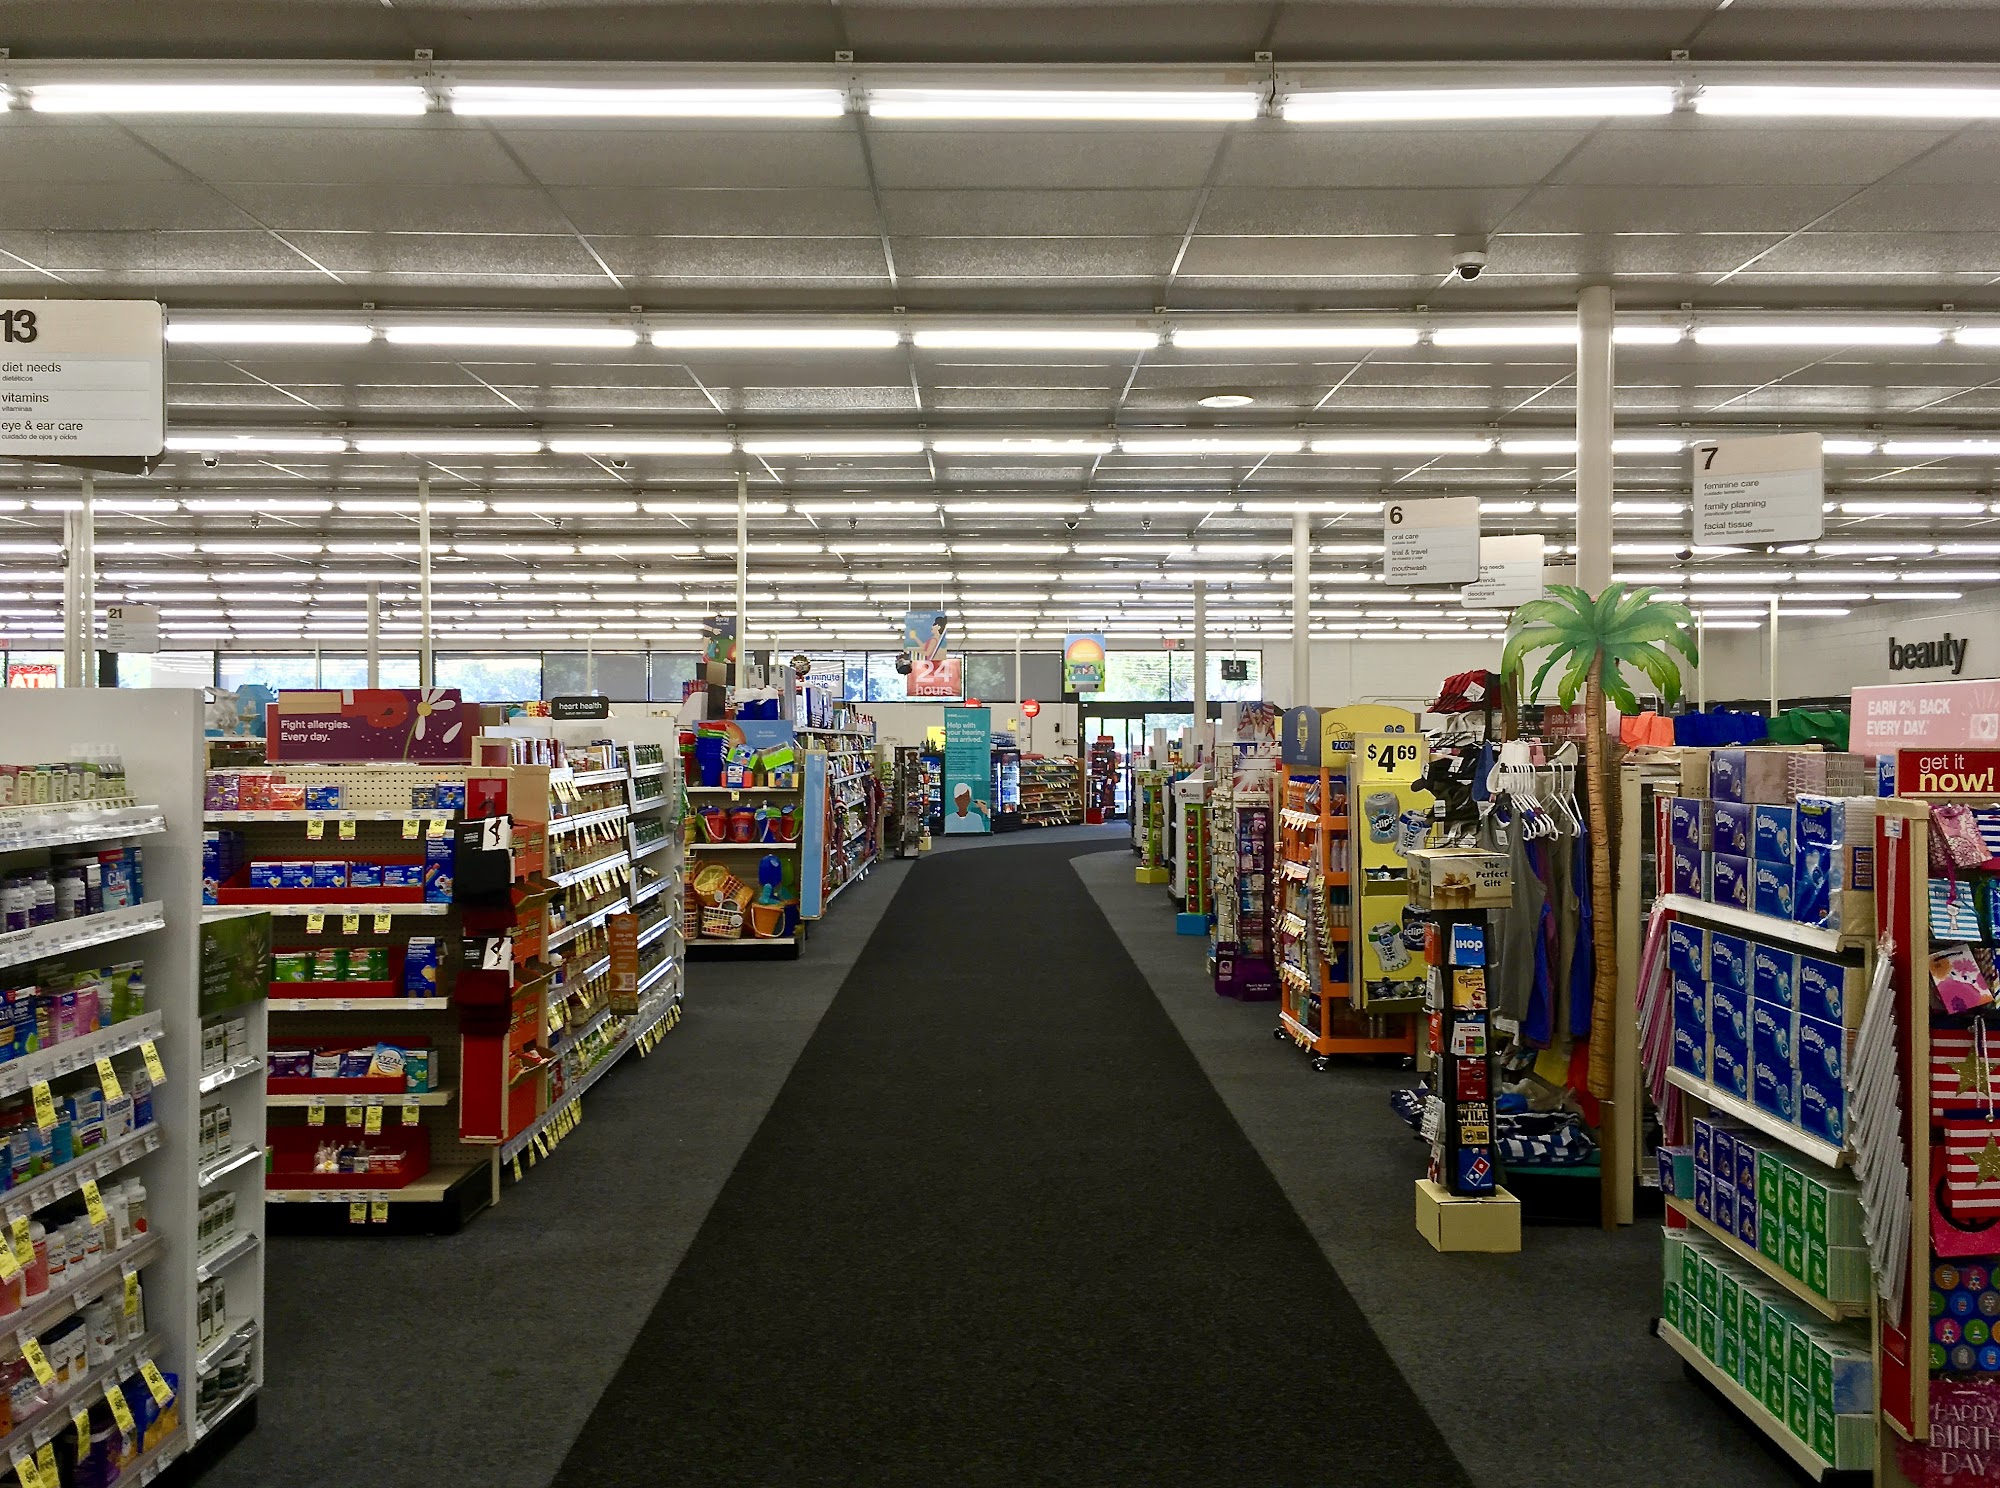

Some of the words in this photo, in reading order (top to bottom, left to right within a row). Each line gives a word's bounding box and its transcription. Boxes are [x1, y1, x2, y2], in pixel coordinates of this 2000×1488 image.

[0, 309, 38, 343] 13
[2, 362, 23, 372] diet
[26, 362, 62, 372] needs
[1, 392, 49, 403] vitamins
[1, 422, 21, 432] eye
[25, 421, 33, 431] &
[36, 422, 55, 431] ear
[58, 422, 83, 431] care
[1701, 447, 1718, 470] 7
[1704, 480, 1739, 490] feminine
[1740, 479, 1760, 488] care
[1704, 502, 1729, 511] family
[1731, 500, 1767, 510] planning
[1389, 506, 1403, 525] 6
[1704, 521, 1726, 530] facial
[1728, 520, 1753, 529] tissue
[109, 608, 123, 619] 21
[1888, 633, 1968, 675] beauty
[916, 660, 953, 683] 24
[915, 685, 953, 696] hours
[559, 702, 578, 710] heart
[580, 702, 603, 710] health
[1867, 700, 1896, 716] EARN
[1899, 699, 1916, 716] 2%
[1920, 698, 1952, 715] BACK
[281, 720, 305, 730] Fight
[307, 720, 351, 731] allergies.
[1866, 720, 1901, 736] EVERY
[281, 732, 308, 743] Every
[310, 732, 331, 743] day.
[1919, 754, 1949, 774] get
[1954, 753, 1964, 770] it
[1919, 767, 1995, 792] now!
[1484, 861, 1500, 869] The
[1476, 870, 1508, 878] Perfect
[1484, 879, 1502, 887] Gift
[1934, 1402, 1998, 1423] HAPPY
[1930, 1424, 2000, 1450] BIRTH
[1941, 1452, 1990, 1476] DAY
